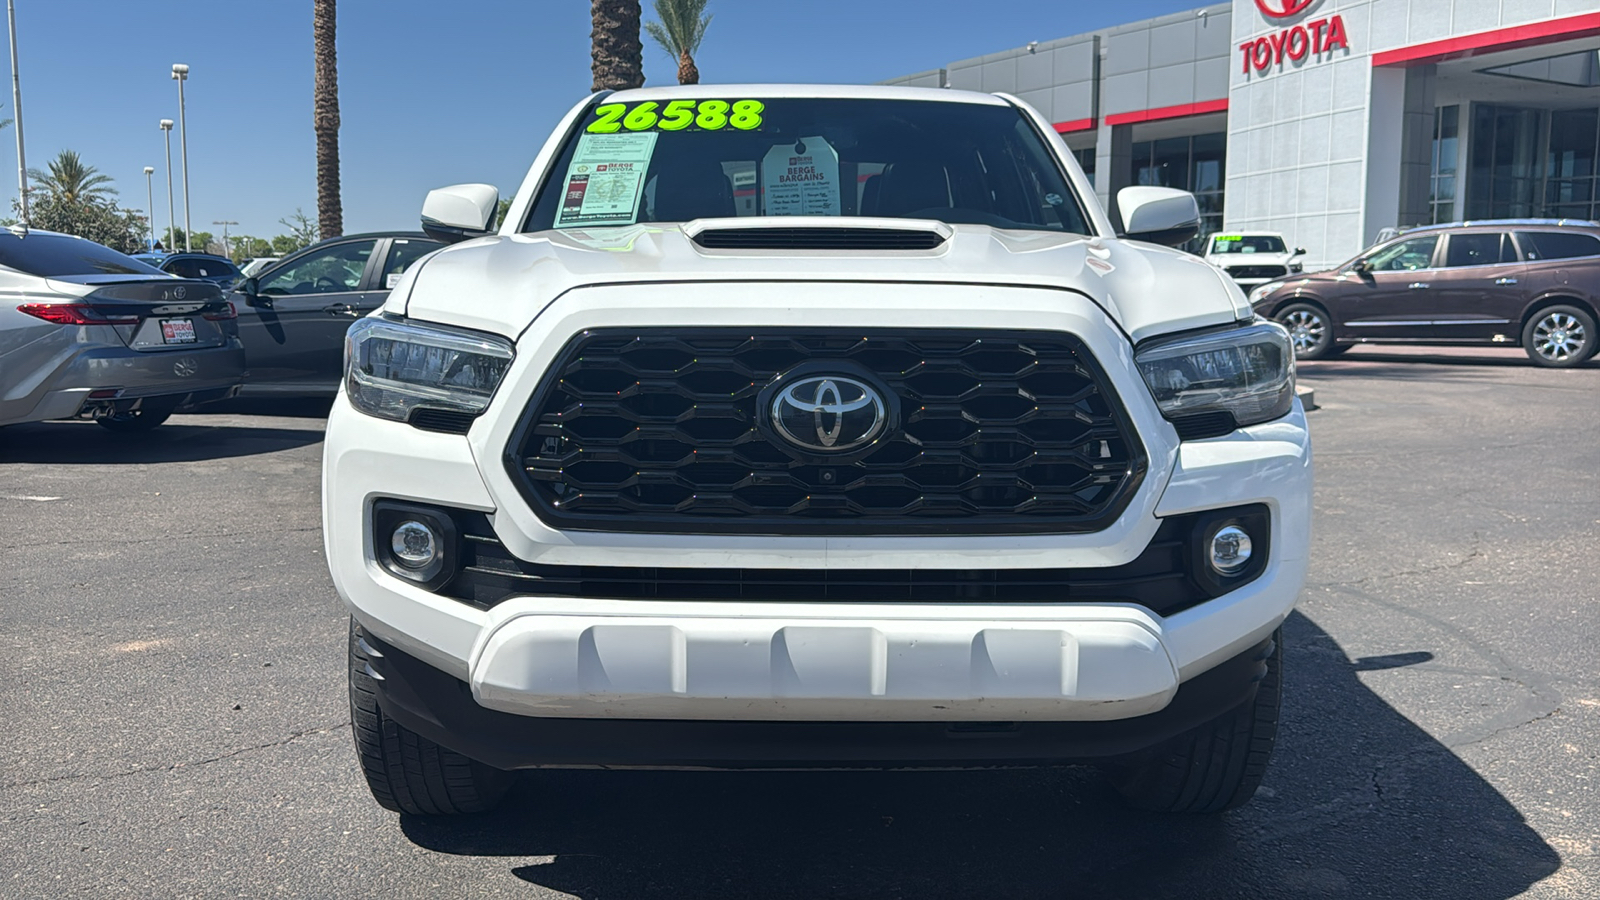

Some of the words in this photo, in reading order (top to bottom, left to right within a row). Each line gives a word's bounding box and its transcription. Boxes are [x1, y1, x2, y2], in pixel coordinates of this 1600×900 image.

[1239, 14, 1349, 75] TOYOTA
[586, 99, 765, 133] 26588
[787, 166, 816, 175] BERGE
[779, 172, 825, 183] BARGAINS
[172, 323, 193, 331] BERGE
